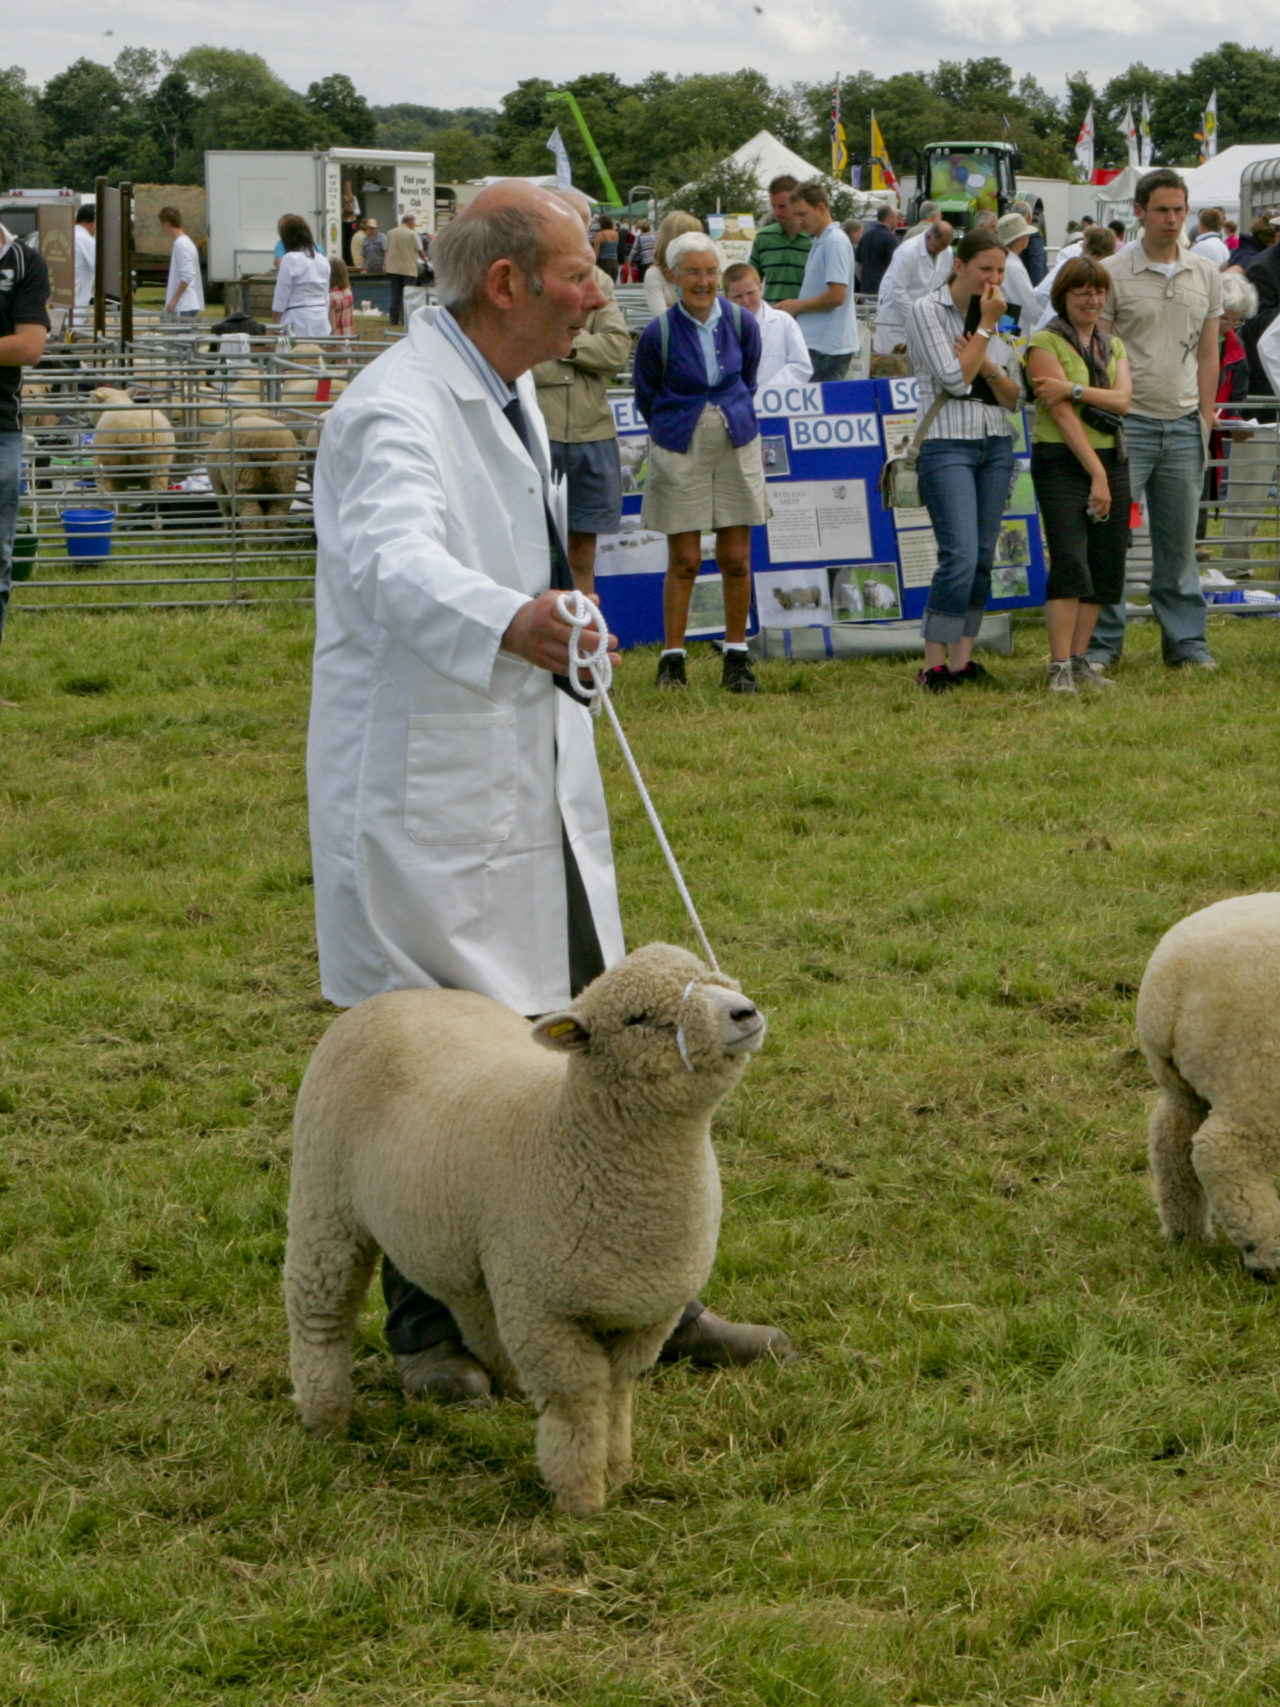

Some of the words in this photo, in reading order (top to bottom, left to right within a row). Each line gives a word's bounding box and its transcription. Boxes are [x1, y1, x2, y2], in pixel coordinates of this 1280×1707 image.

[403, 175, 414, 184] Find
[416, 178, 427, 187] your
[400, 187, 419, 195] Nearest
[410, 198, 422, 207] Club
[614, 402, 647, 427] EL
[794, 418, 875, 445] BOOK
